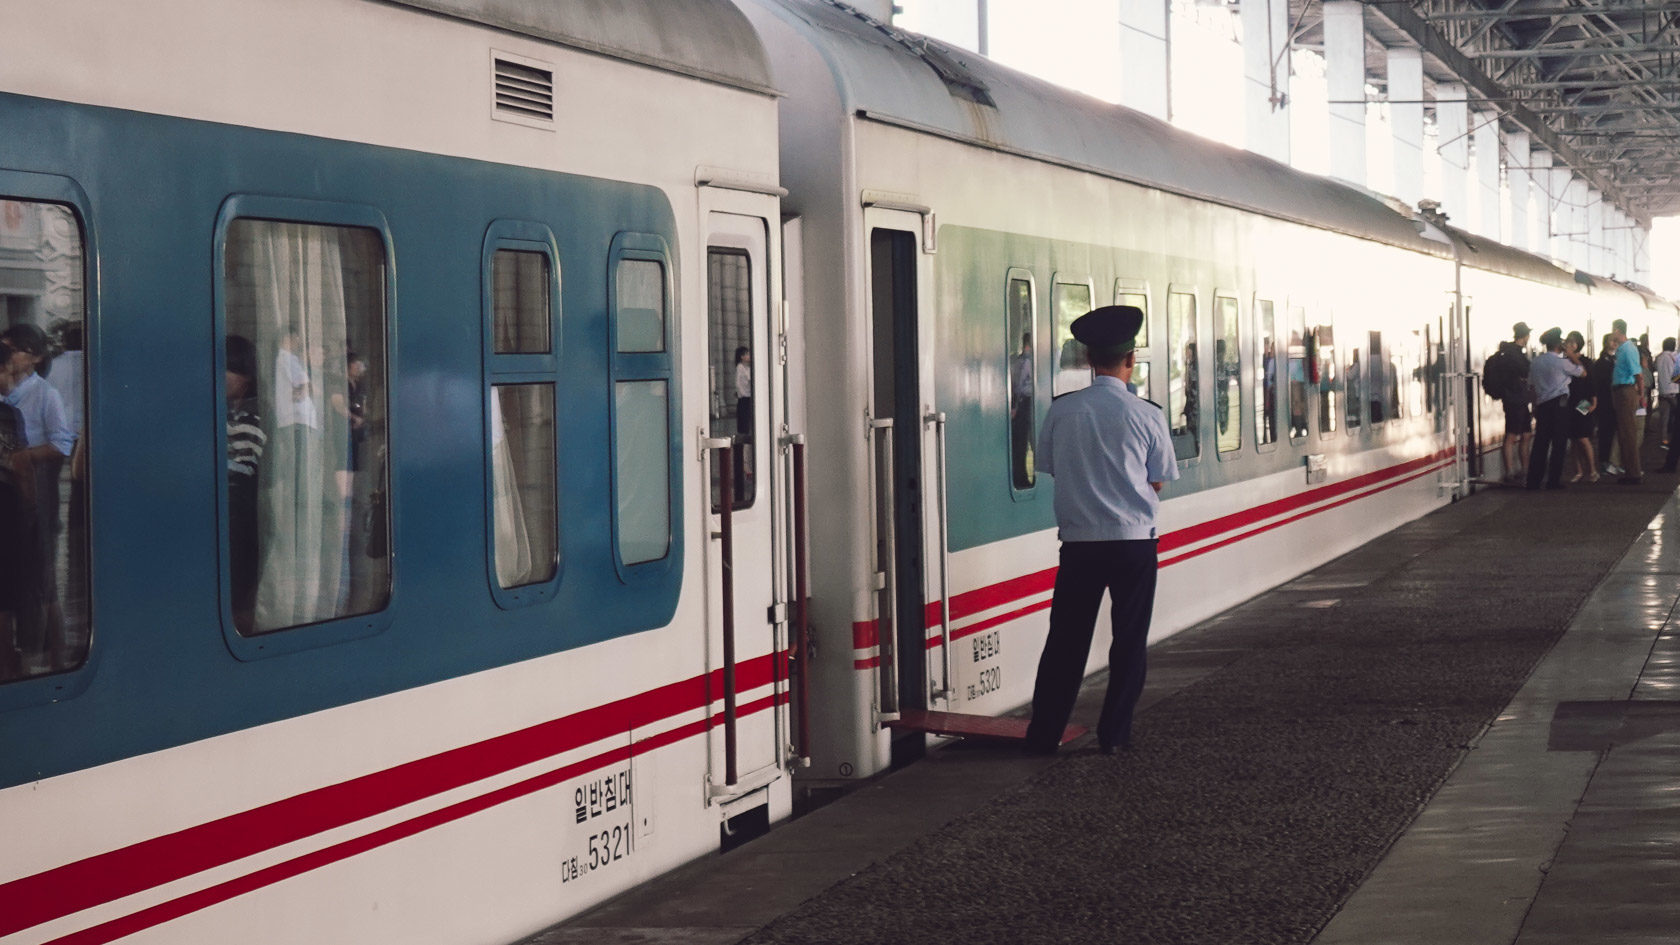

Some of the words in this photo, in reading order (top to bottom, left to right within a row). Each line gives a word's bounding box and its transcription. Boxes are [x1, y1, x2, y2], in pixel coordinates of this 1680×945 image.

[980, 666, 1001, 696] 5320
[575, 769, 632, 824] 일반침대
[588, 822, 630, 871] 5321
